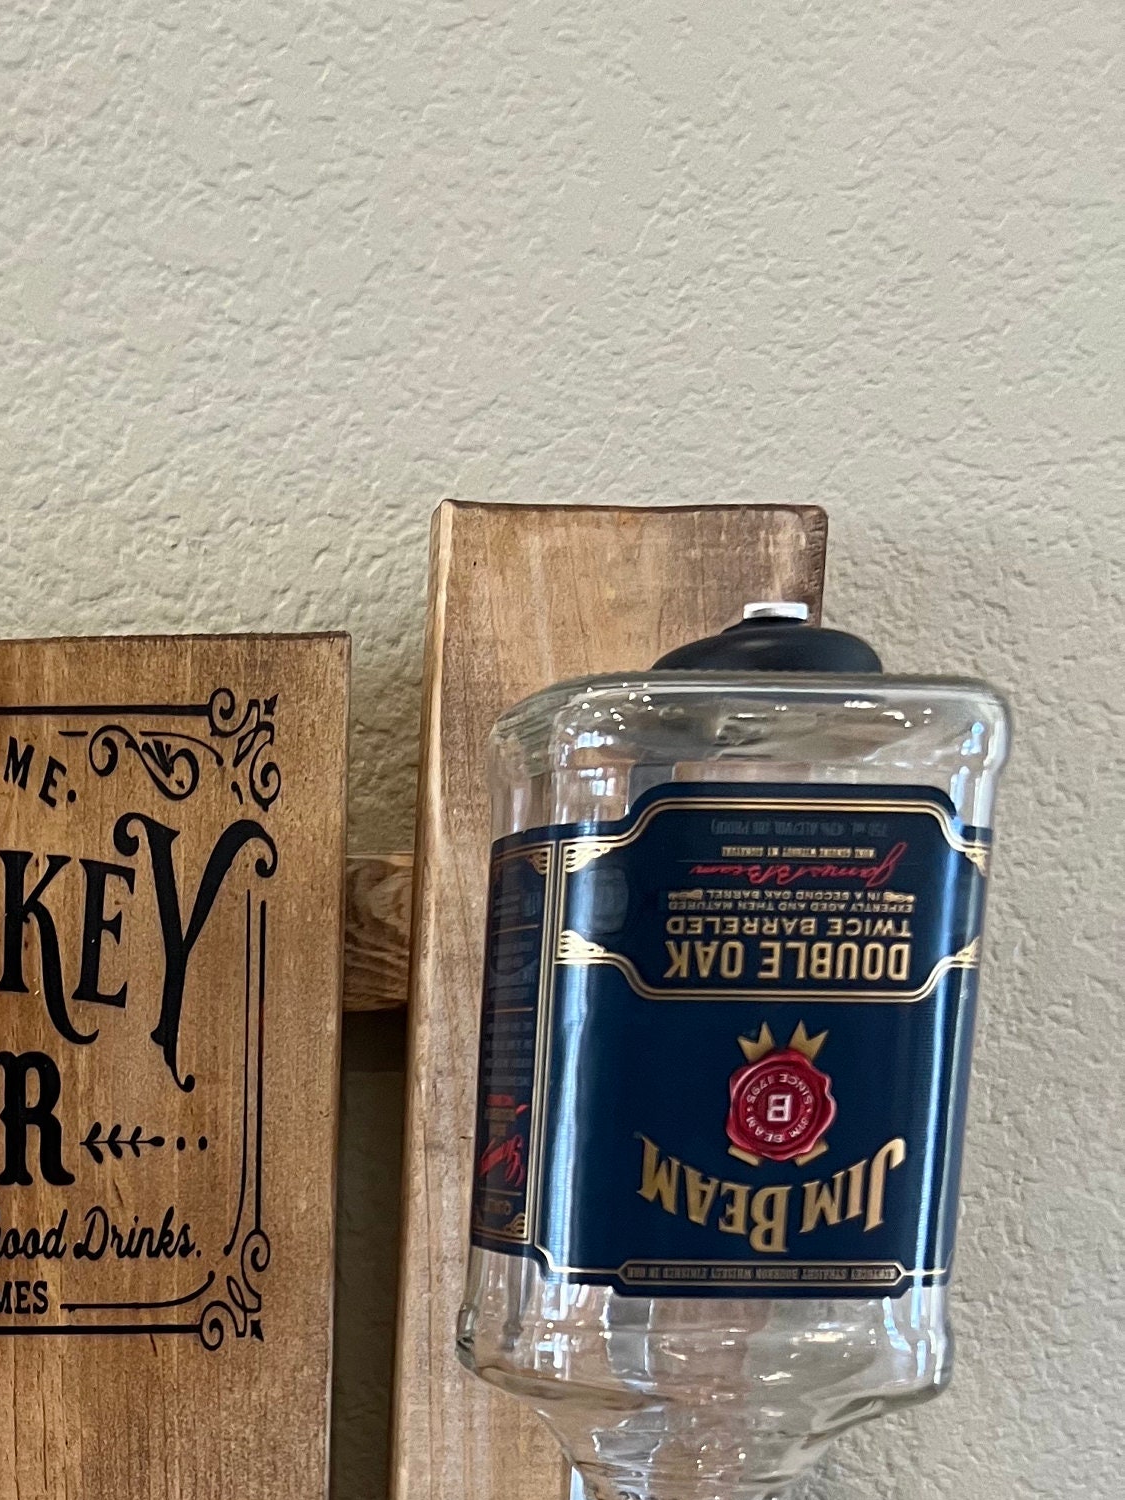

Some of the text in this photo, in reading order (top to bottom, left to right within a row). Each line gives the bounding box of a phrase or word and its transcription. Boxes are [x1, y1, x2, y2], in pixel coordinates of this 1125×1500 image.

[764, 890, 792, 899] OAK
[796, 891, 850, 900] SECOND
[855, 892, 863, 900] A
[867, 892, 880, 901] IN
[668, 901, 913, 913] EXPERTLY AGED AND THEN MATURED
[665, 916, 912, 937] TWICE BARRELED
[663, 940, 912, 980] DOUBLE OAK
[779, 1074, 813, 1104] SINCE
[767, 1094, 791, 1122] B
[746, 1116, 809, 1143] JIM BEAM
[637, 1134, 790, 1253] BEAM
[800, 1136, 905, 1234] JIM
